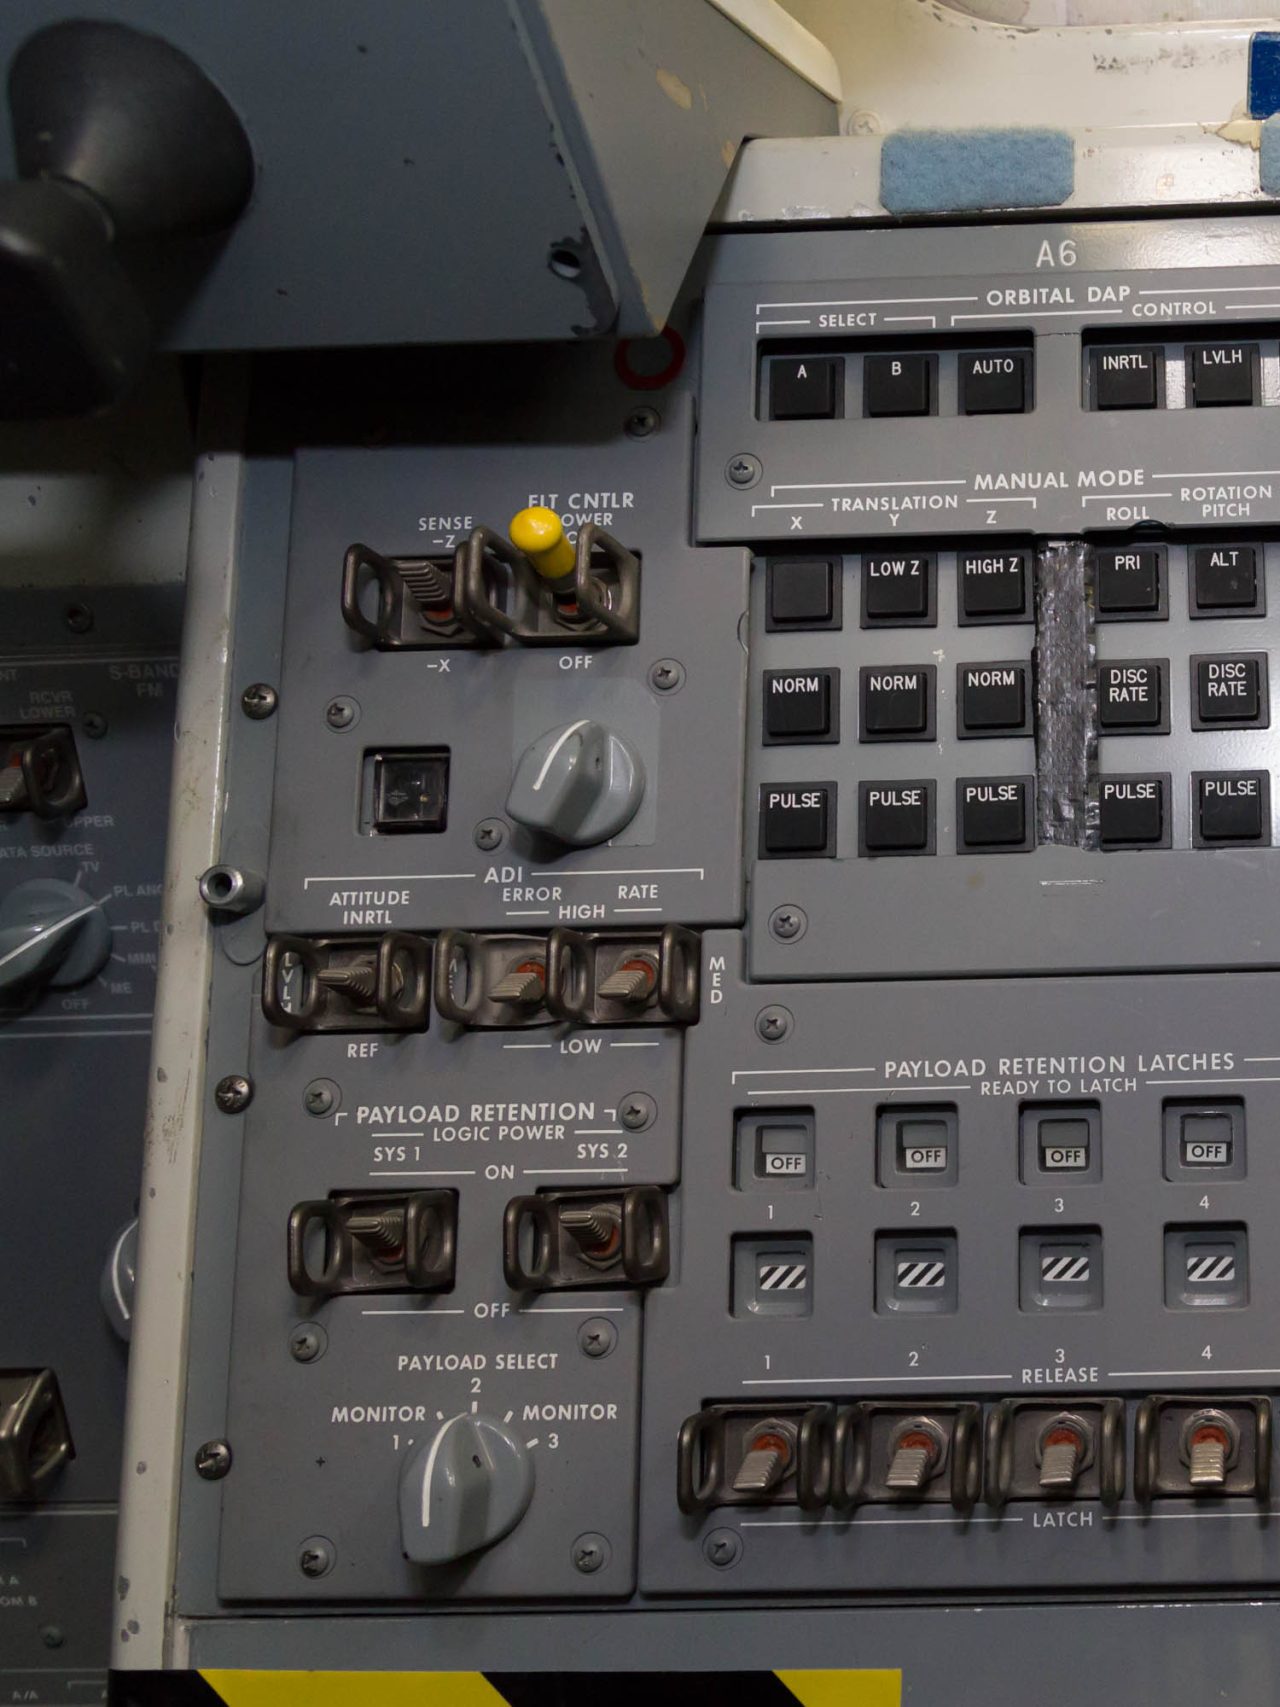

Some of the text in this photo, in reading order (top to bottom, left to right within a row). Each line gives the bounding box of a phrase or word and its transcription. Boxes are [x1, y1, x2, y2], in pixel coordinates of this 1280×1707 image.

[1036, 239, 1077, 268] A6
[986, 285, 1131, 306] ORBITAL DAP
[1132, 301, 1216, 317] CONTROL
[818, 313, 877, 327] SELECT
[1103, 355, 1148, 370] INRTL
[1203, 350, 1242, 365] LVLH
[797, 365, 807, 378] A
[892, 362, 902, 375] B
[973, 359, 1014, 374] AUTO
[974, 470, 1144, 490] MANUAL MODE
[569, 492, 635, 508] CNTLR
[1181, 486, 1272, 501] ROTATION
[831, 495, 958, 511] TRANSLATION
[1202, 503, 1250, 517] PITCH
[1107, 507, 1150, 520] ROLL
[418, 517, 472, 531] SENSE
[965, 558, 1019, 575] HIGH Z
[1115, 555, 1140, 570] PRI
[1210, 552, 1238, 567] ALT
[870, 561, 920, 576] LOW Z
[1110, 669, 1147, 684] DISC
[772, 677, 819, 693] NORM
[1109, 687, 1148, 702] RATE
[19, 706, 76, 719] LOWER
[1104, 783, 1156, 799] PULSE
[770, 792, 820, 808] PULSE
[31, 844, 95, 857] SOURCE
[82, 861, 100, 872] TV
[484, 867, 523, 883] ADI
[330, 891, 410, 907] ATTITUDE
[503, 887, 562, 901] ERROR
[618, 885, 658, 899] RATE
[344, 911, 392, 924] INRTL
[558, 905, 606, 919] HIGH
[347, 1044, 379, 1058] REF
[884, 1053, 1234, 1078] PAYLOAD RETENTION LATCHES
[981, 1078, 1137, 1095] READY TO LATCH
[356, 1103, 595, 1123] PAYLOAD RETENTION
[433, 1126, 565, 1142] LOGIC POWER
[374, 1146, 421, 1162] SYS 1
[577, 1143, 628, 1159] SYS 2
[1051, 1151, 1081, 1163] OFF
[771, 1157, 802, 1170] OFF
[485, 1165, 514, 1180] ON
[475, 1304, 510, 1318] OFF
[398, 1353, 559, 1371] PAYLOAD SELECT
[1022, 1367, 1098, 1384] RELEASE
[332, 1406, 425, 1422] MONITOR
[523, 1404, 617, 1420] MONITOR
[1033, 1513, 1093, 1528] LATCH
